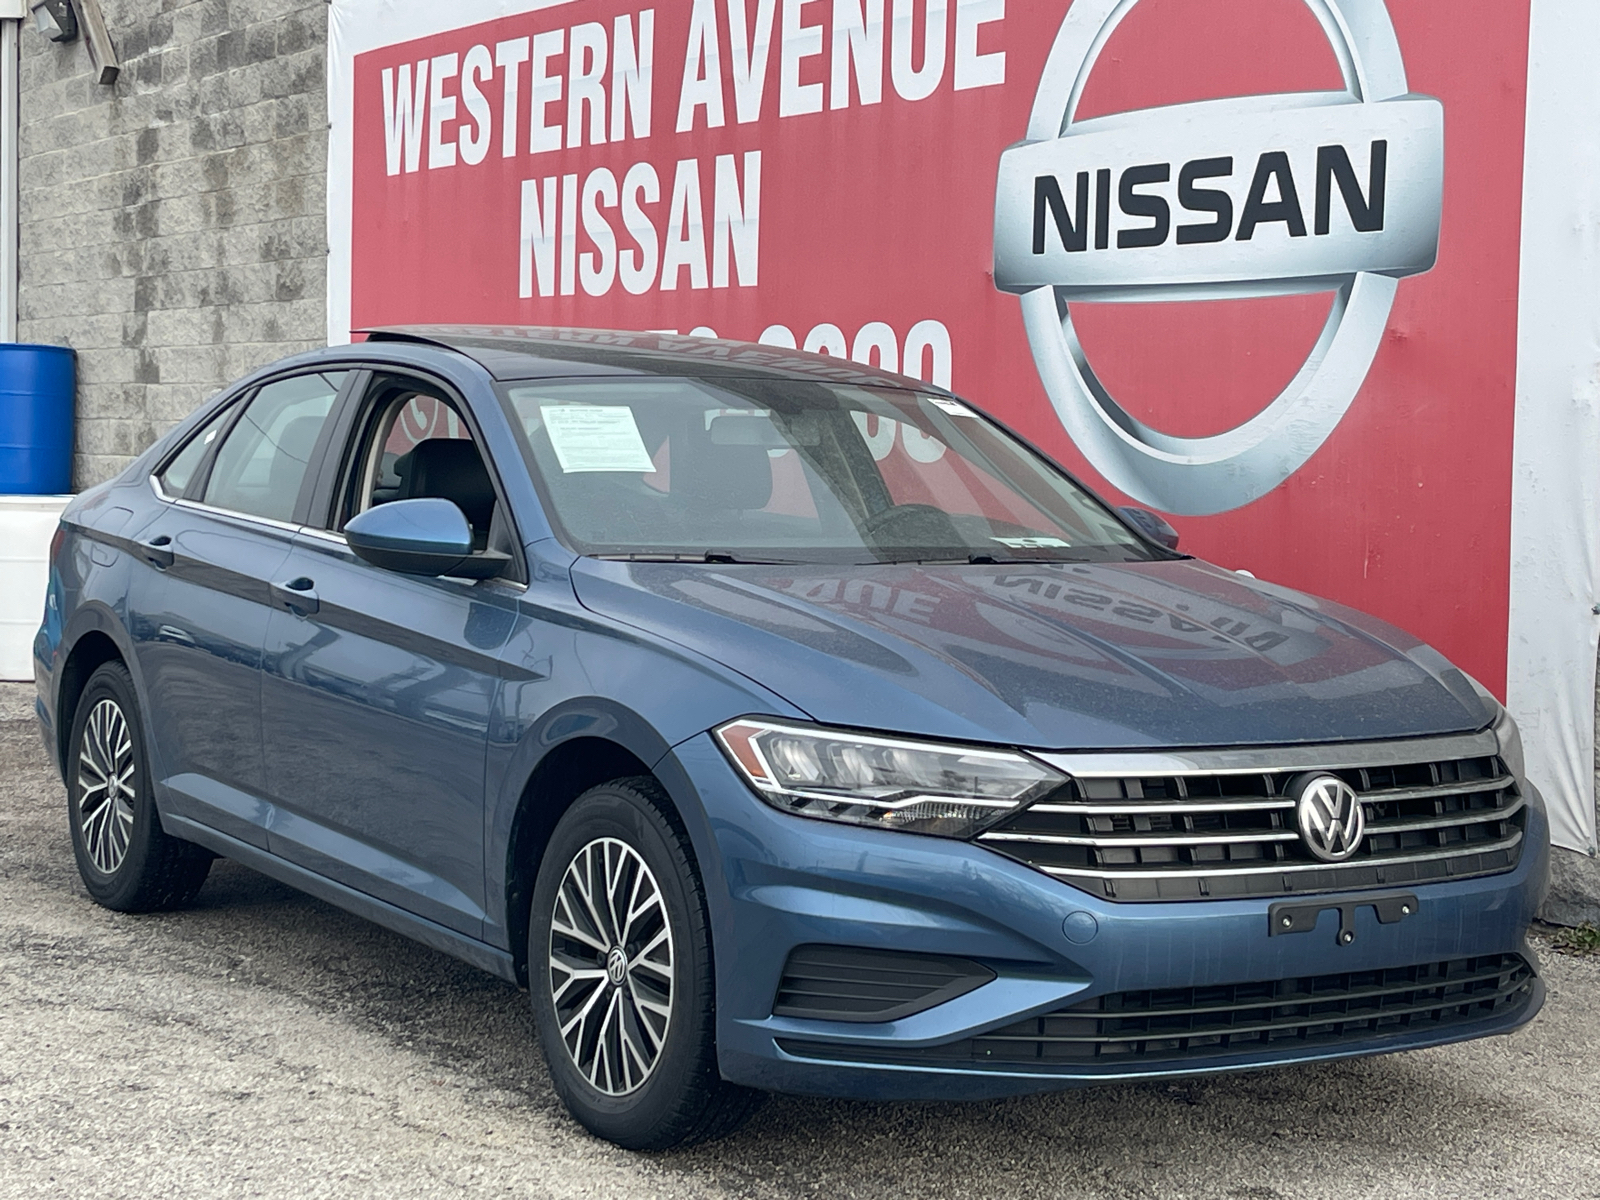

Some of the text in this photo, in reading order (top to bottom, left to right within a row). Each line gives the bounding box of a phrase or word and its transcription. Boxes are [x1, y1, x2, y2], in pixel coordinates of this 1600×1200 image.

[381, 0, 1006, 176] WESTERN AVENUE
[519, 150, 762, 299] NISSAN
[1032, 139, 1388, 255] NISSAN
